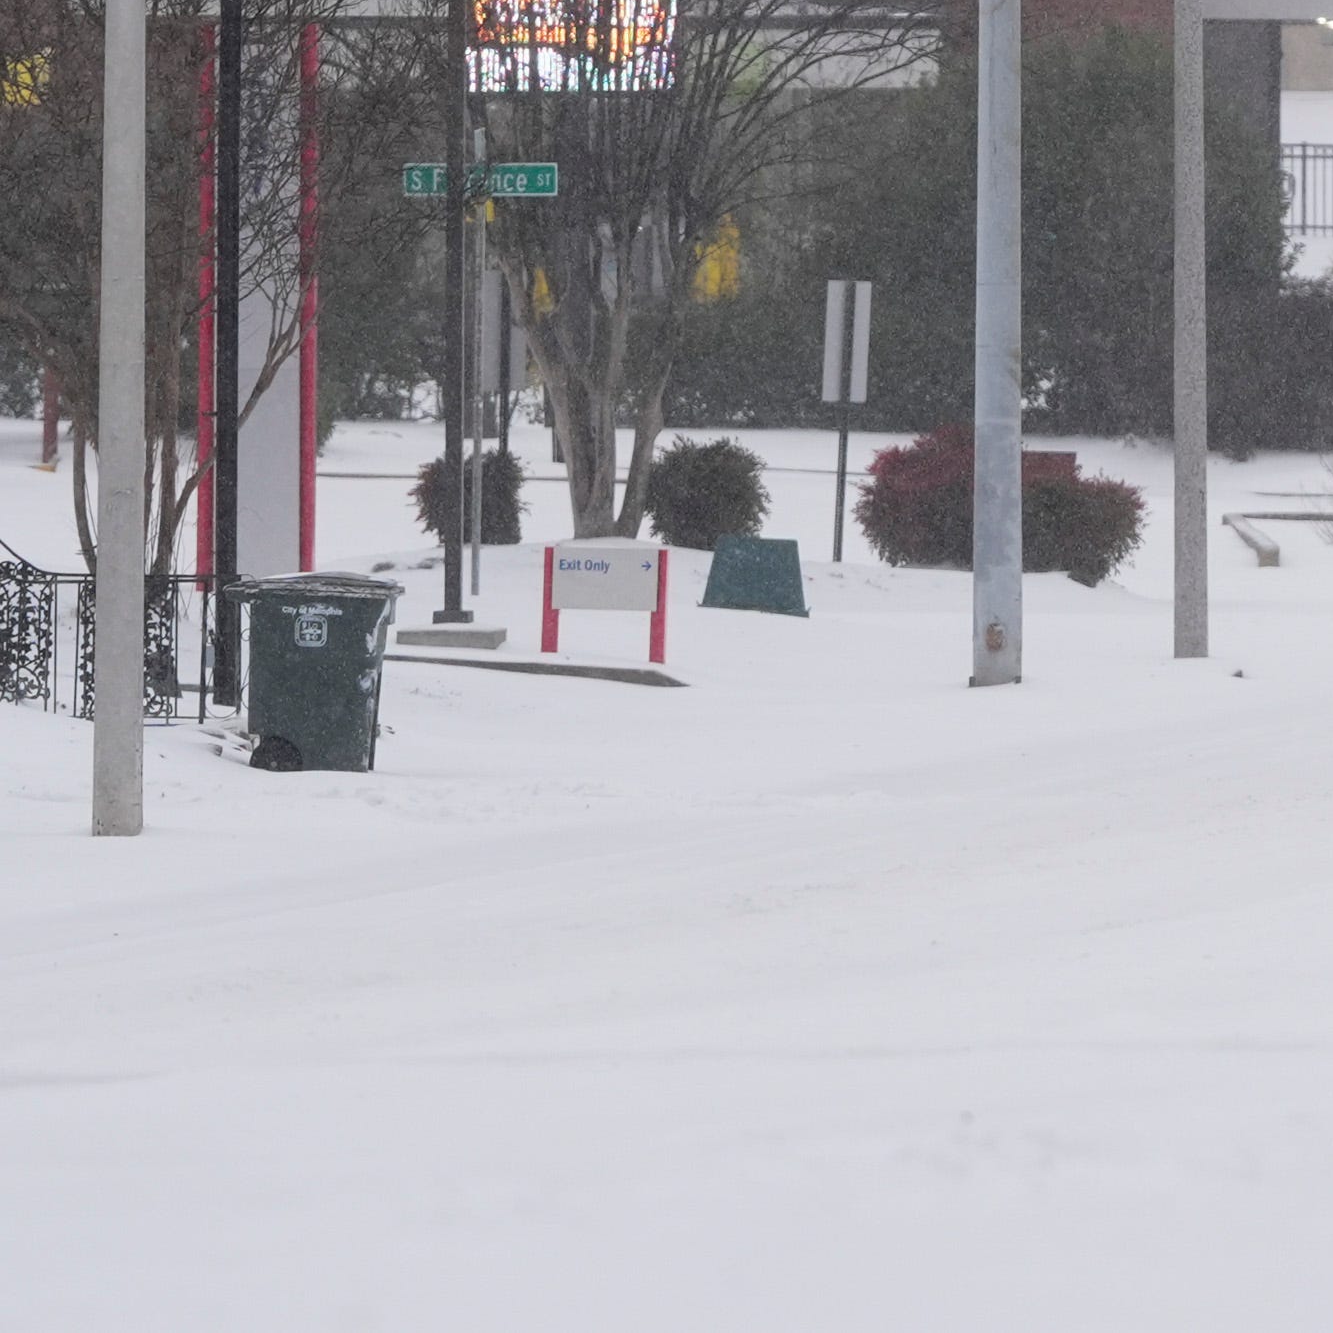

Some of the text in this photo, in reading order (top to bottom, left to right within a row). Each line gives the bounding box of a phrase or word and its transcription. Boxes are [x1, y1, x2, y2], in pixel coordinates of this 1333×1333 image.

[411, 168, 552, 192] S Fnce ST
[559, 558, 611, 574] Exit Only
